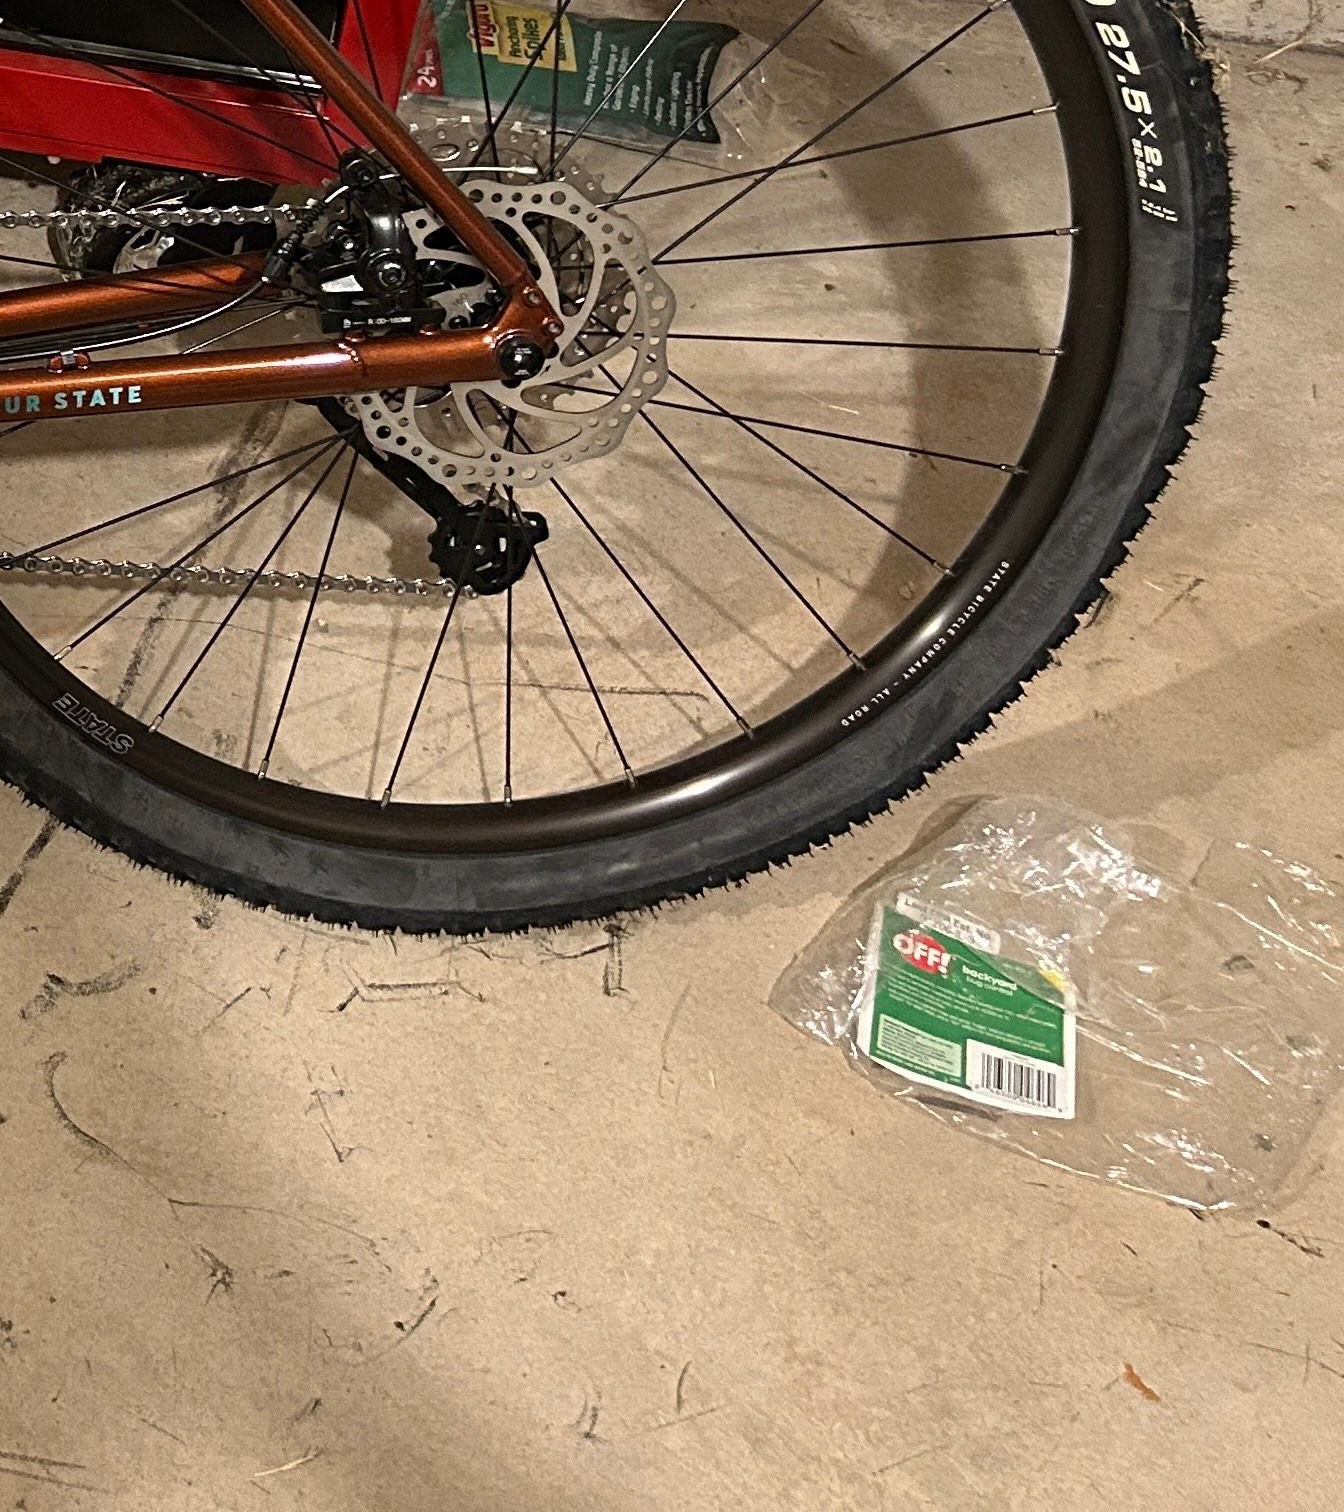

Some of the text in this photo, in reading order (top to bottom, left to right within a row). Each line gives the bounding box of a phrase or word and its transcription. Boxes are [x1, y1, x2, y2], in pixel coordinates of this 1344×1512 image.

[416, 65, 438, 88] 24
[54, 385, 142, 410] STATE
[982, 560, 1010, 594] STATE
[946, 594, 985, 637] BICYCLE
[902, 637, 947, 680] COMPANY
[871, 687, 891, 704] ALL
[52, 692, 135, 755] STATE
[841, 704, 870, 727] ROAD
[893, 931, 952, 975] OFF!
[962, 965, 1018, 990] backyard
